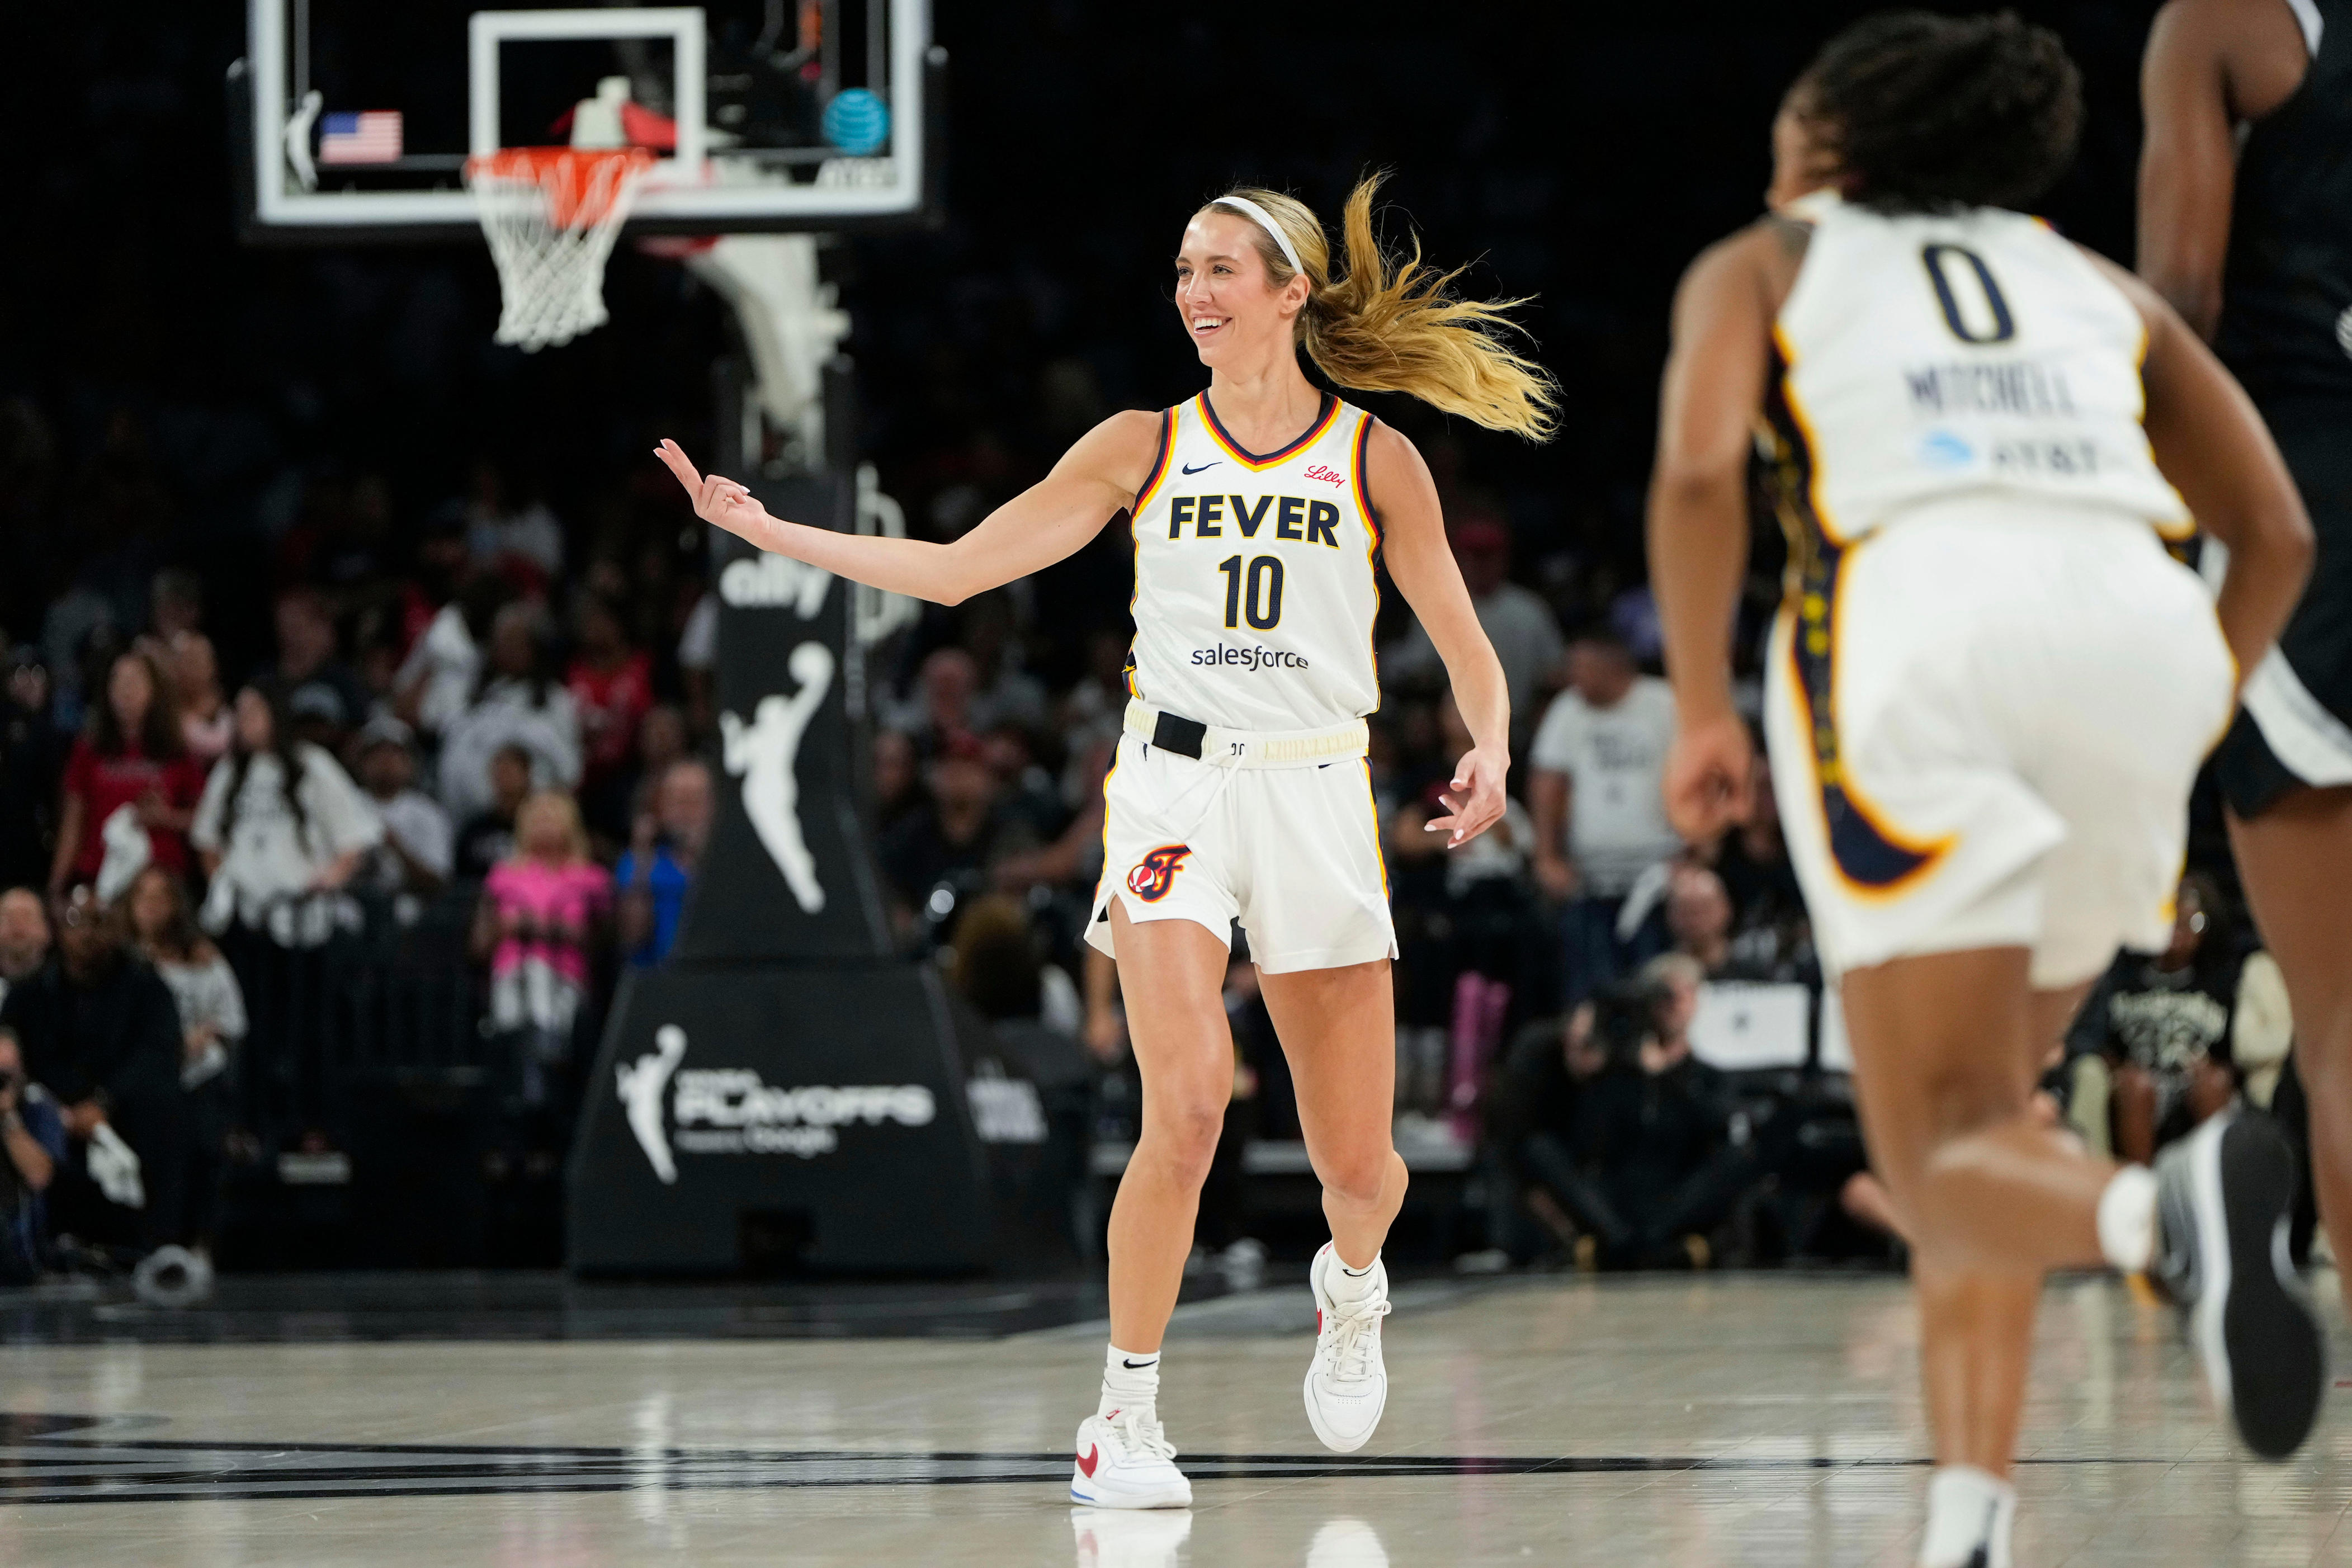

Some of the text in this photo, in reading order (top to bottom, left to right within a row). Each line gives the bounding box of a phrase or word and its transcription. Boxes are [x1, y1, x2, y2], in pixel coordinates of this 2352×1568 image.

[1923, 244, 2015, 343] 0
[1304, 465, 1345, 488] Lilly
[1168, 495, 1340, 549] FEVER
[1218, 555, 1283, 631] 10
[1191, 643, 1309, 671] salesforce
